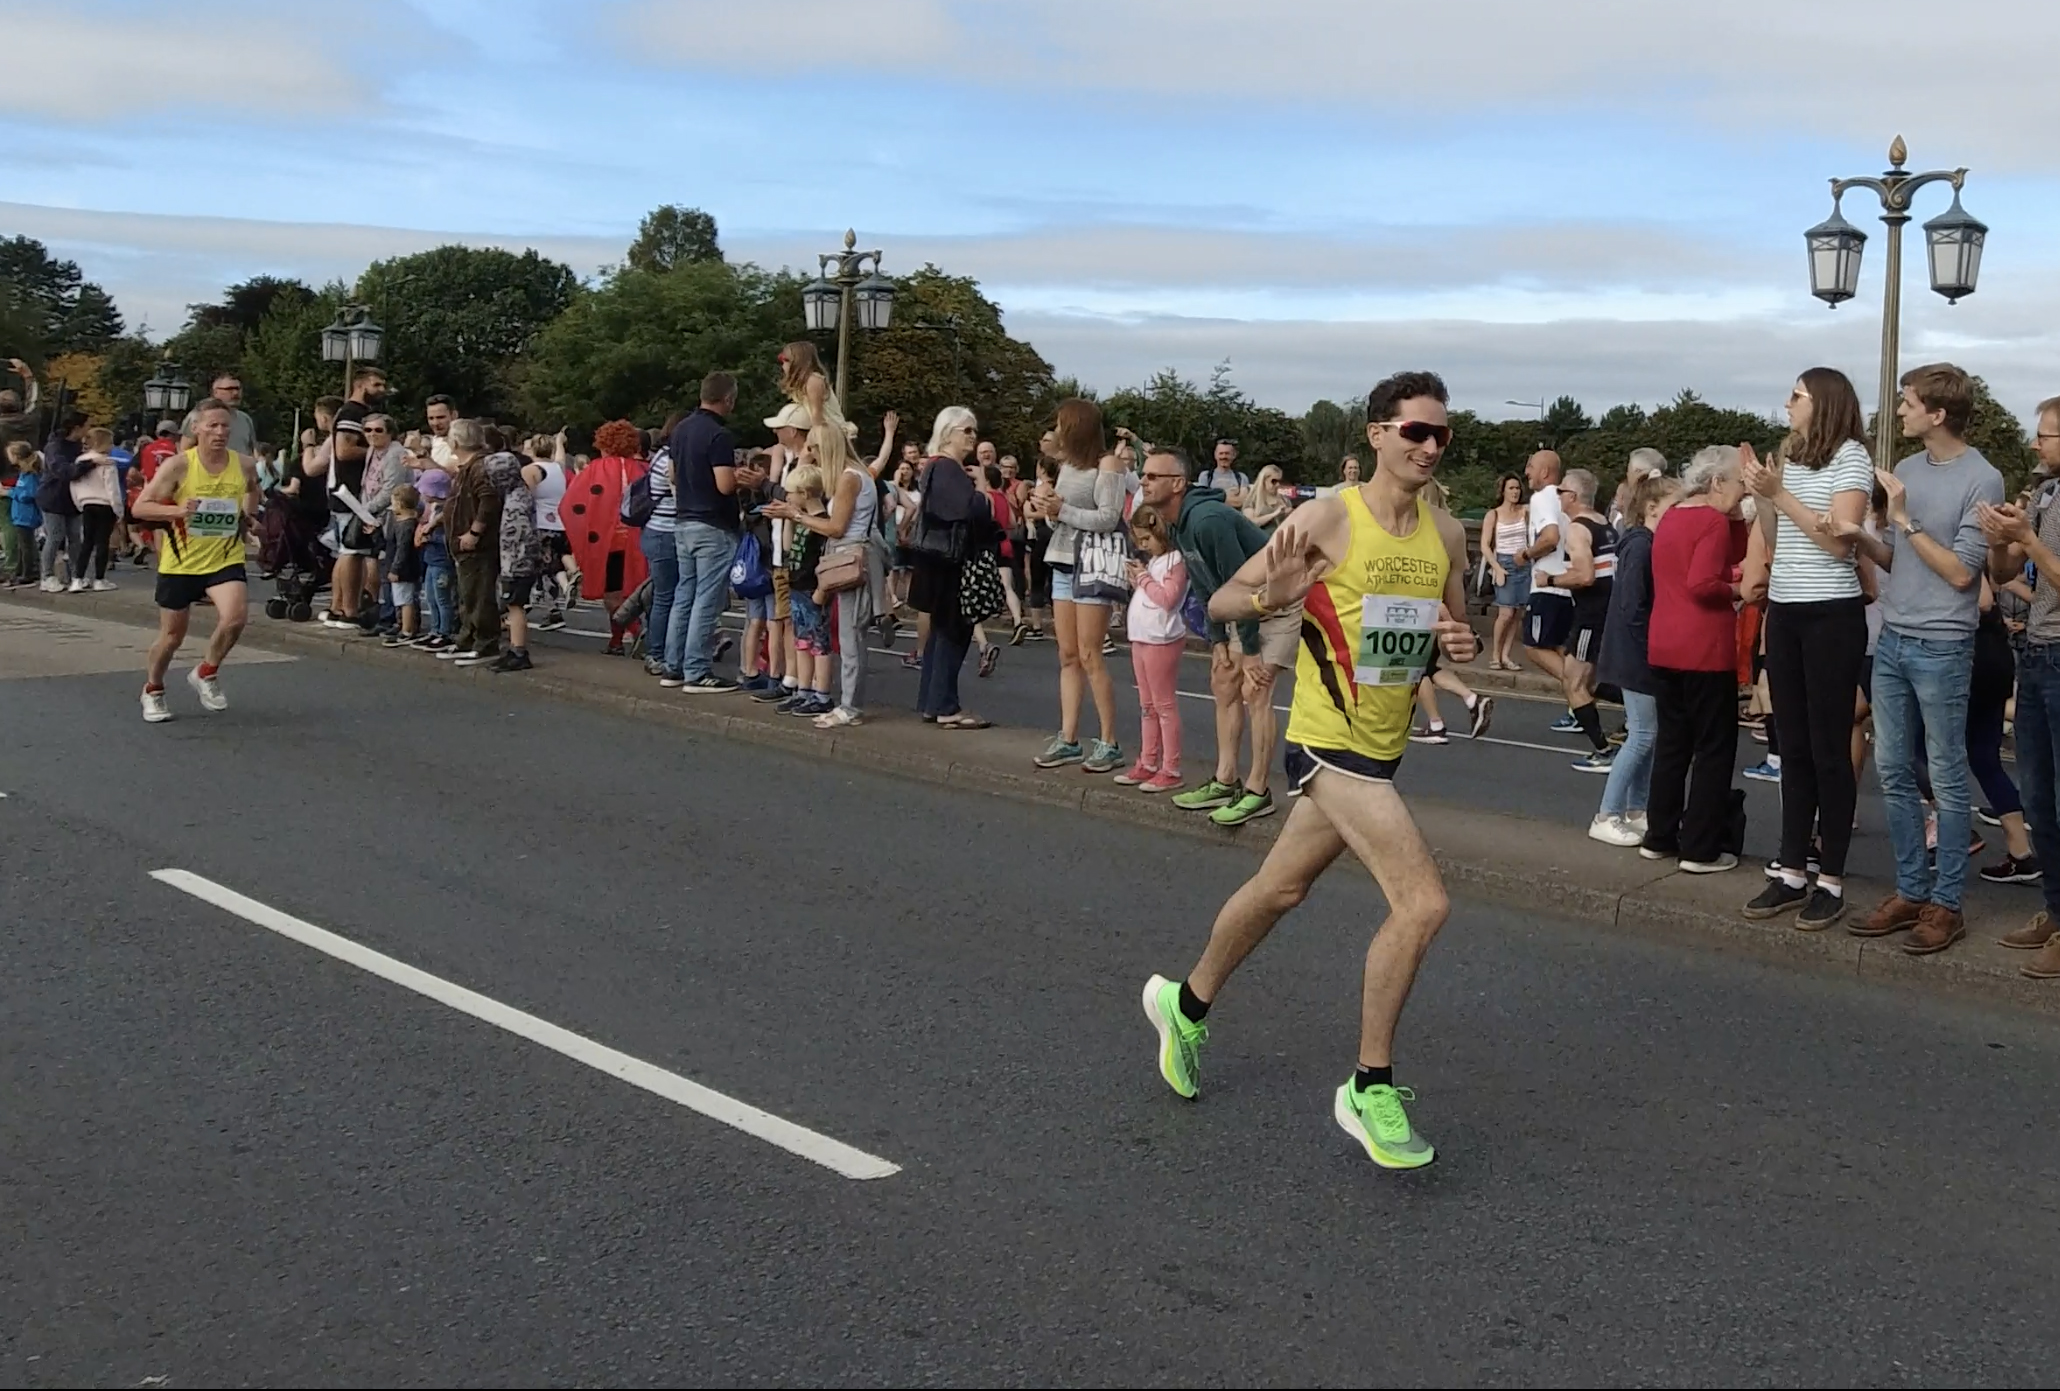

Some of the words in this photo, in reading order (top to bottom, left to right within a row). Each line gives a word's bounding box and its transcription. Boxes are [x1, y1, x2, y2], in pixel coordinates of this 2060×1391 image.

[193, 512, 235, 525] 3070
[1363, 556, 1439, 575] WORCESTER
[1366, 573, 1412, 586] ATHLETIC
[1413, 575, 1438, 588] CLUB
[1366, 630, 1432, 656] 1007
